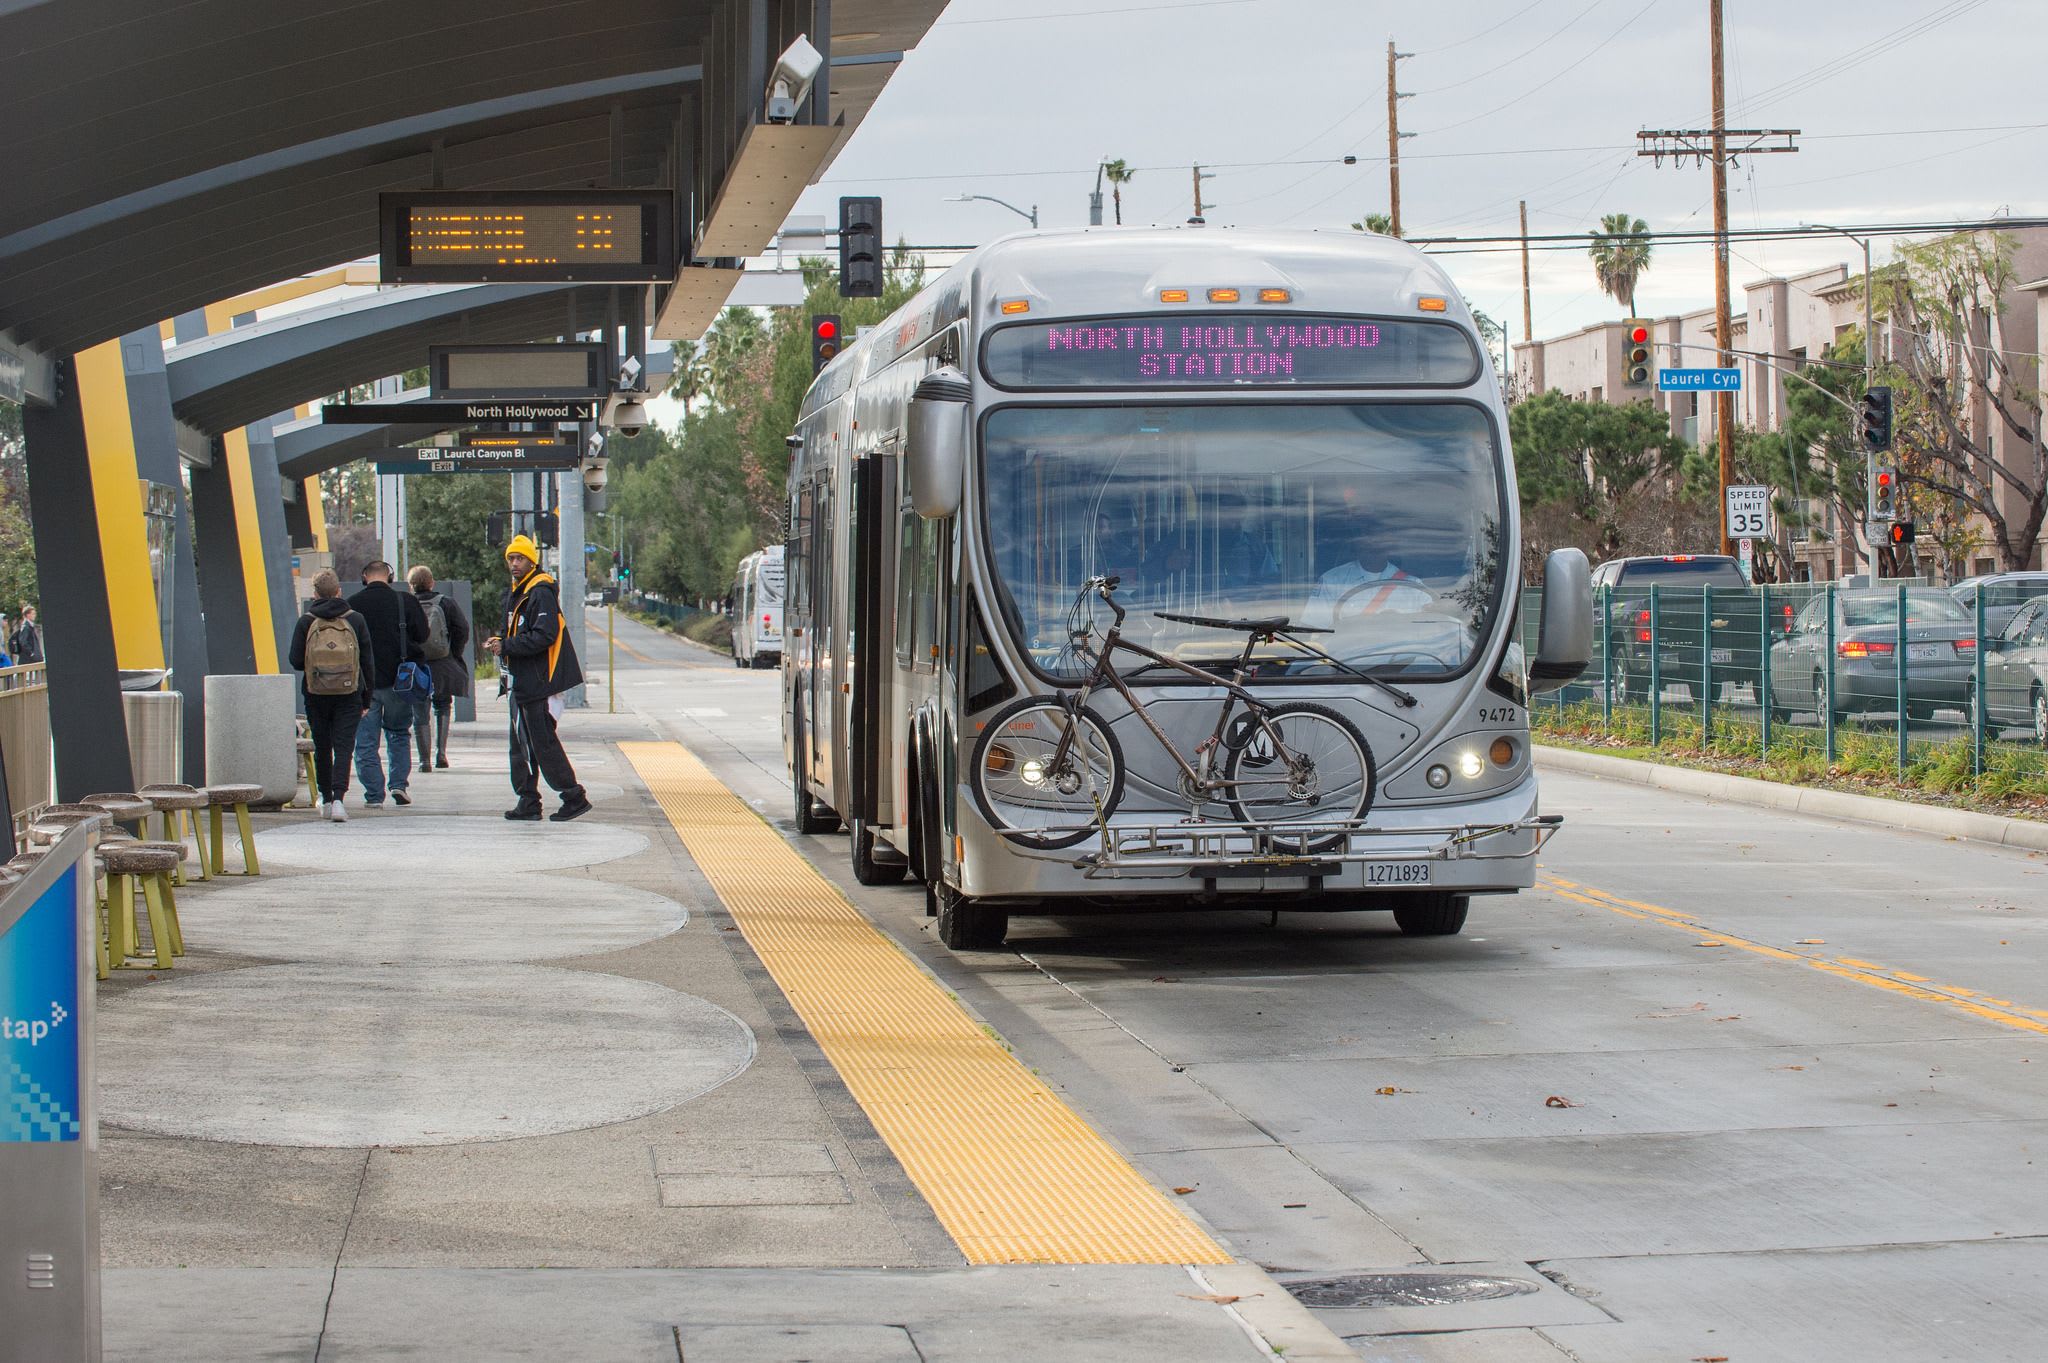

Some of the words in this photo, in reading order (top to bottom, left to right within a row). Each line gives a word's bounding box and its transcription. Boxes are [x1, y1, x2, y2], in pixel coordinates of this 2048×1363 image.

[1048, 327, 1164, 350] NORTH
[1181, 325, 1380, 348] HOLLYWOOD
[1139, 352, 1294, 375] STATION
[1663, 372, 1705, 385] Laurel
[1713, 372, 1738, 387] Cyn
[467, 406, 502, 417] North
[506, 405, 569, 420] Hollywood
[420, 450, 439, 459] Exit
[444, 449, 476, 459] Laurel
[477, 450, 512, 460] Canyon
[514, 449, 526, 458] Bl
[434, 462, 452, 470] Exit
[1730, 491, 1765, 499] SPEED
[1733, 502, 1762, 511] LIMIT
[1733, 514, 1764, 532] 35
[1479, 708, 1515, 722] 9472
[1368, 864, 1429, 882] 1271893
[1, 1016, 49, 1046] tap
